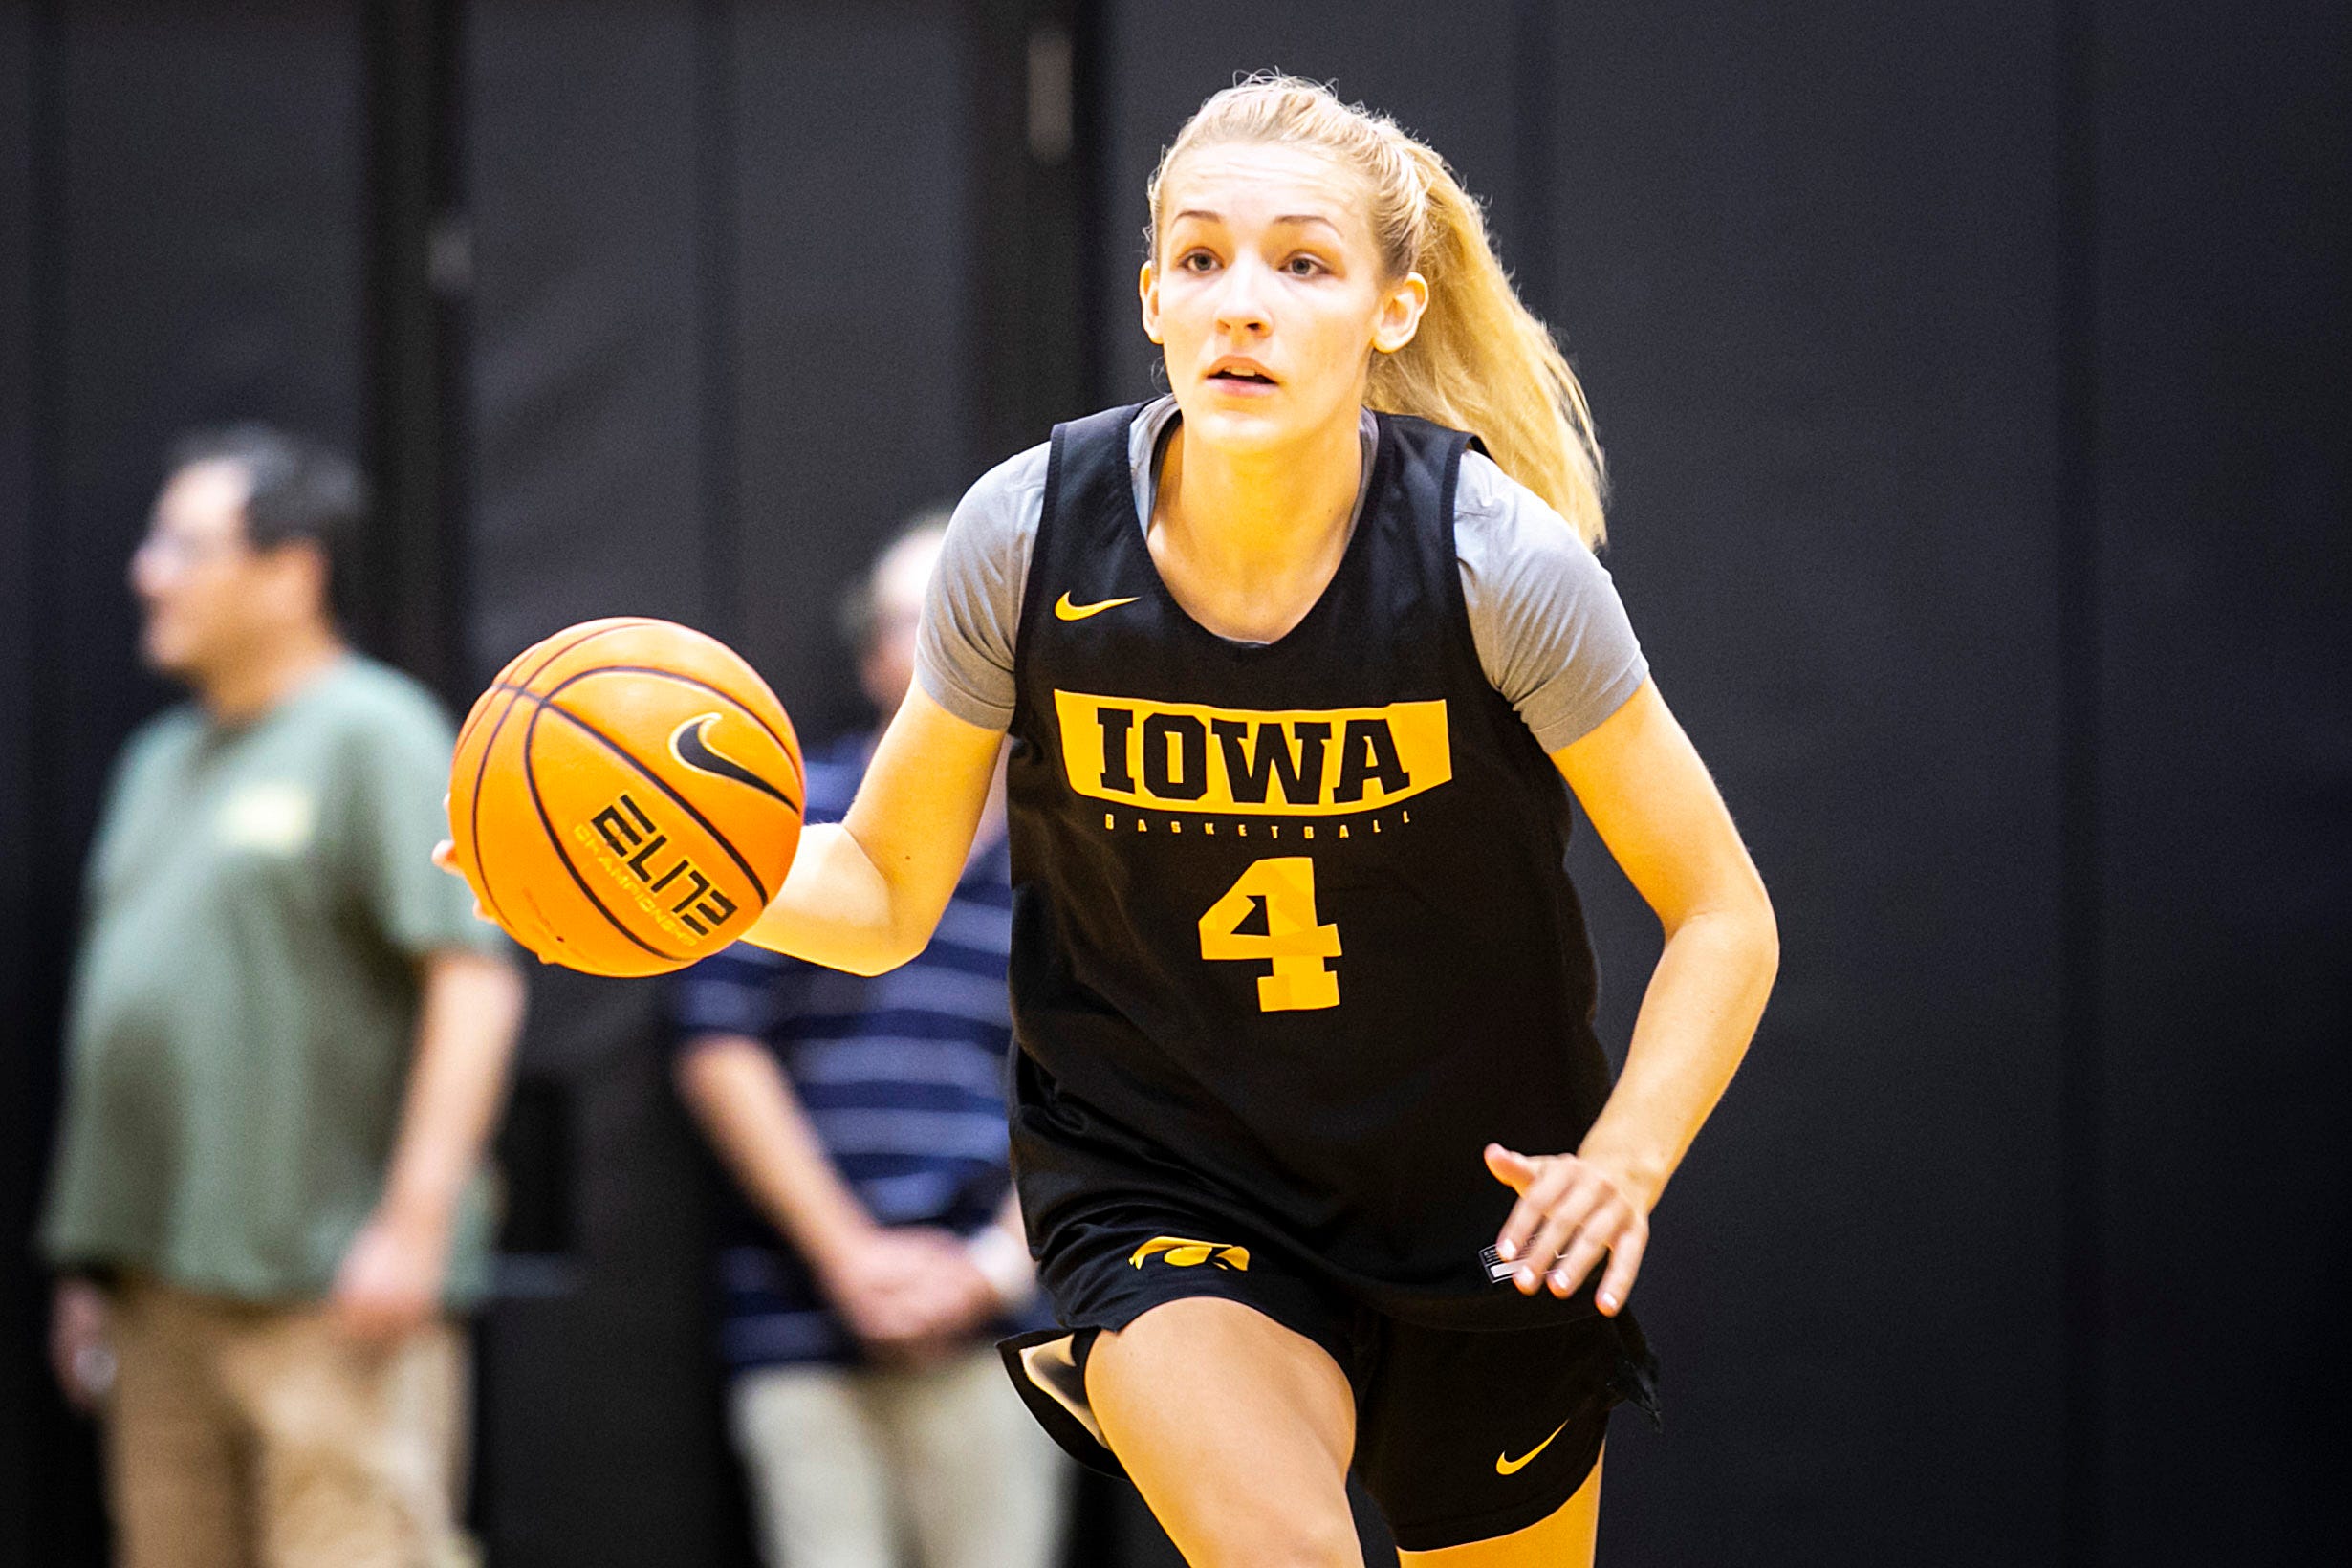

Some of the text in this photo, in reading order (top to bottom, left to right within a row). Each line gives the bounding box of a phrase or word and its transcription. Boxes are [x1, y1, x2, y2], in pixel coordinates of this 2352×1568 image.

[1097, 707, 1410, 805] IOWA
[1104, 810, 1410, 839] BASKETBALL
[1198, 857, 1342, 1013] 4
